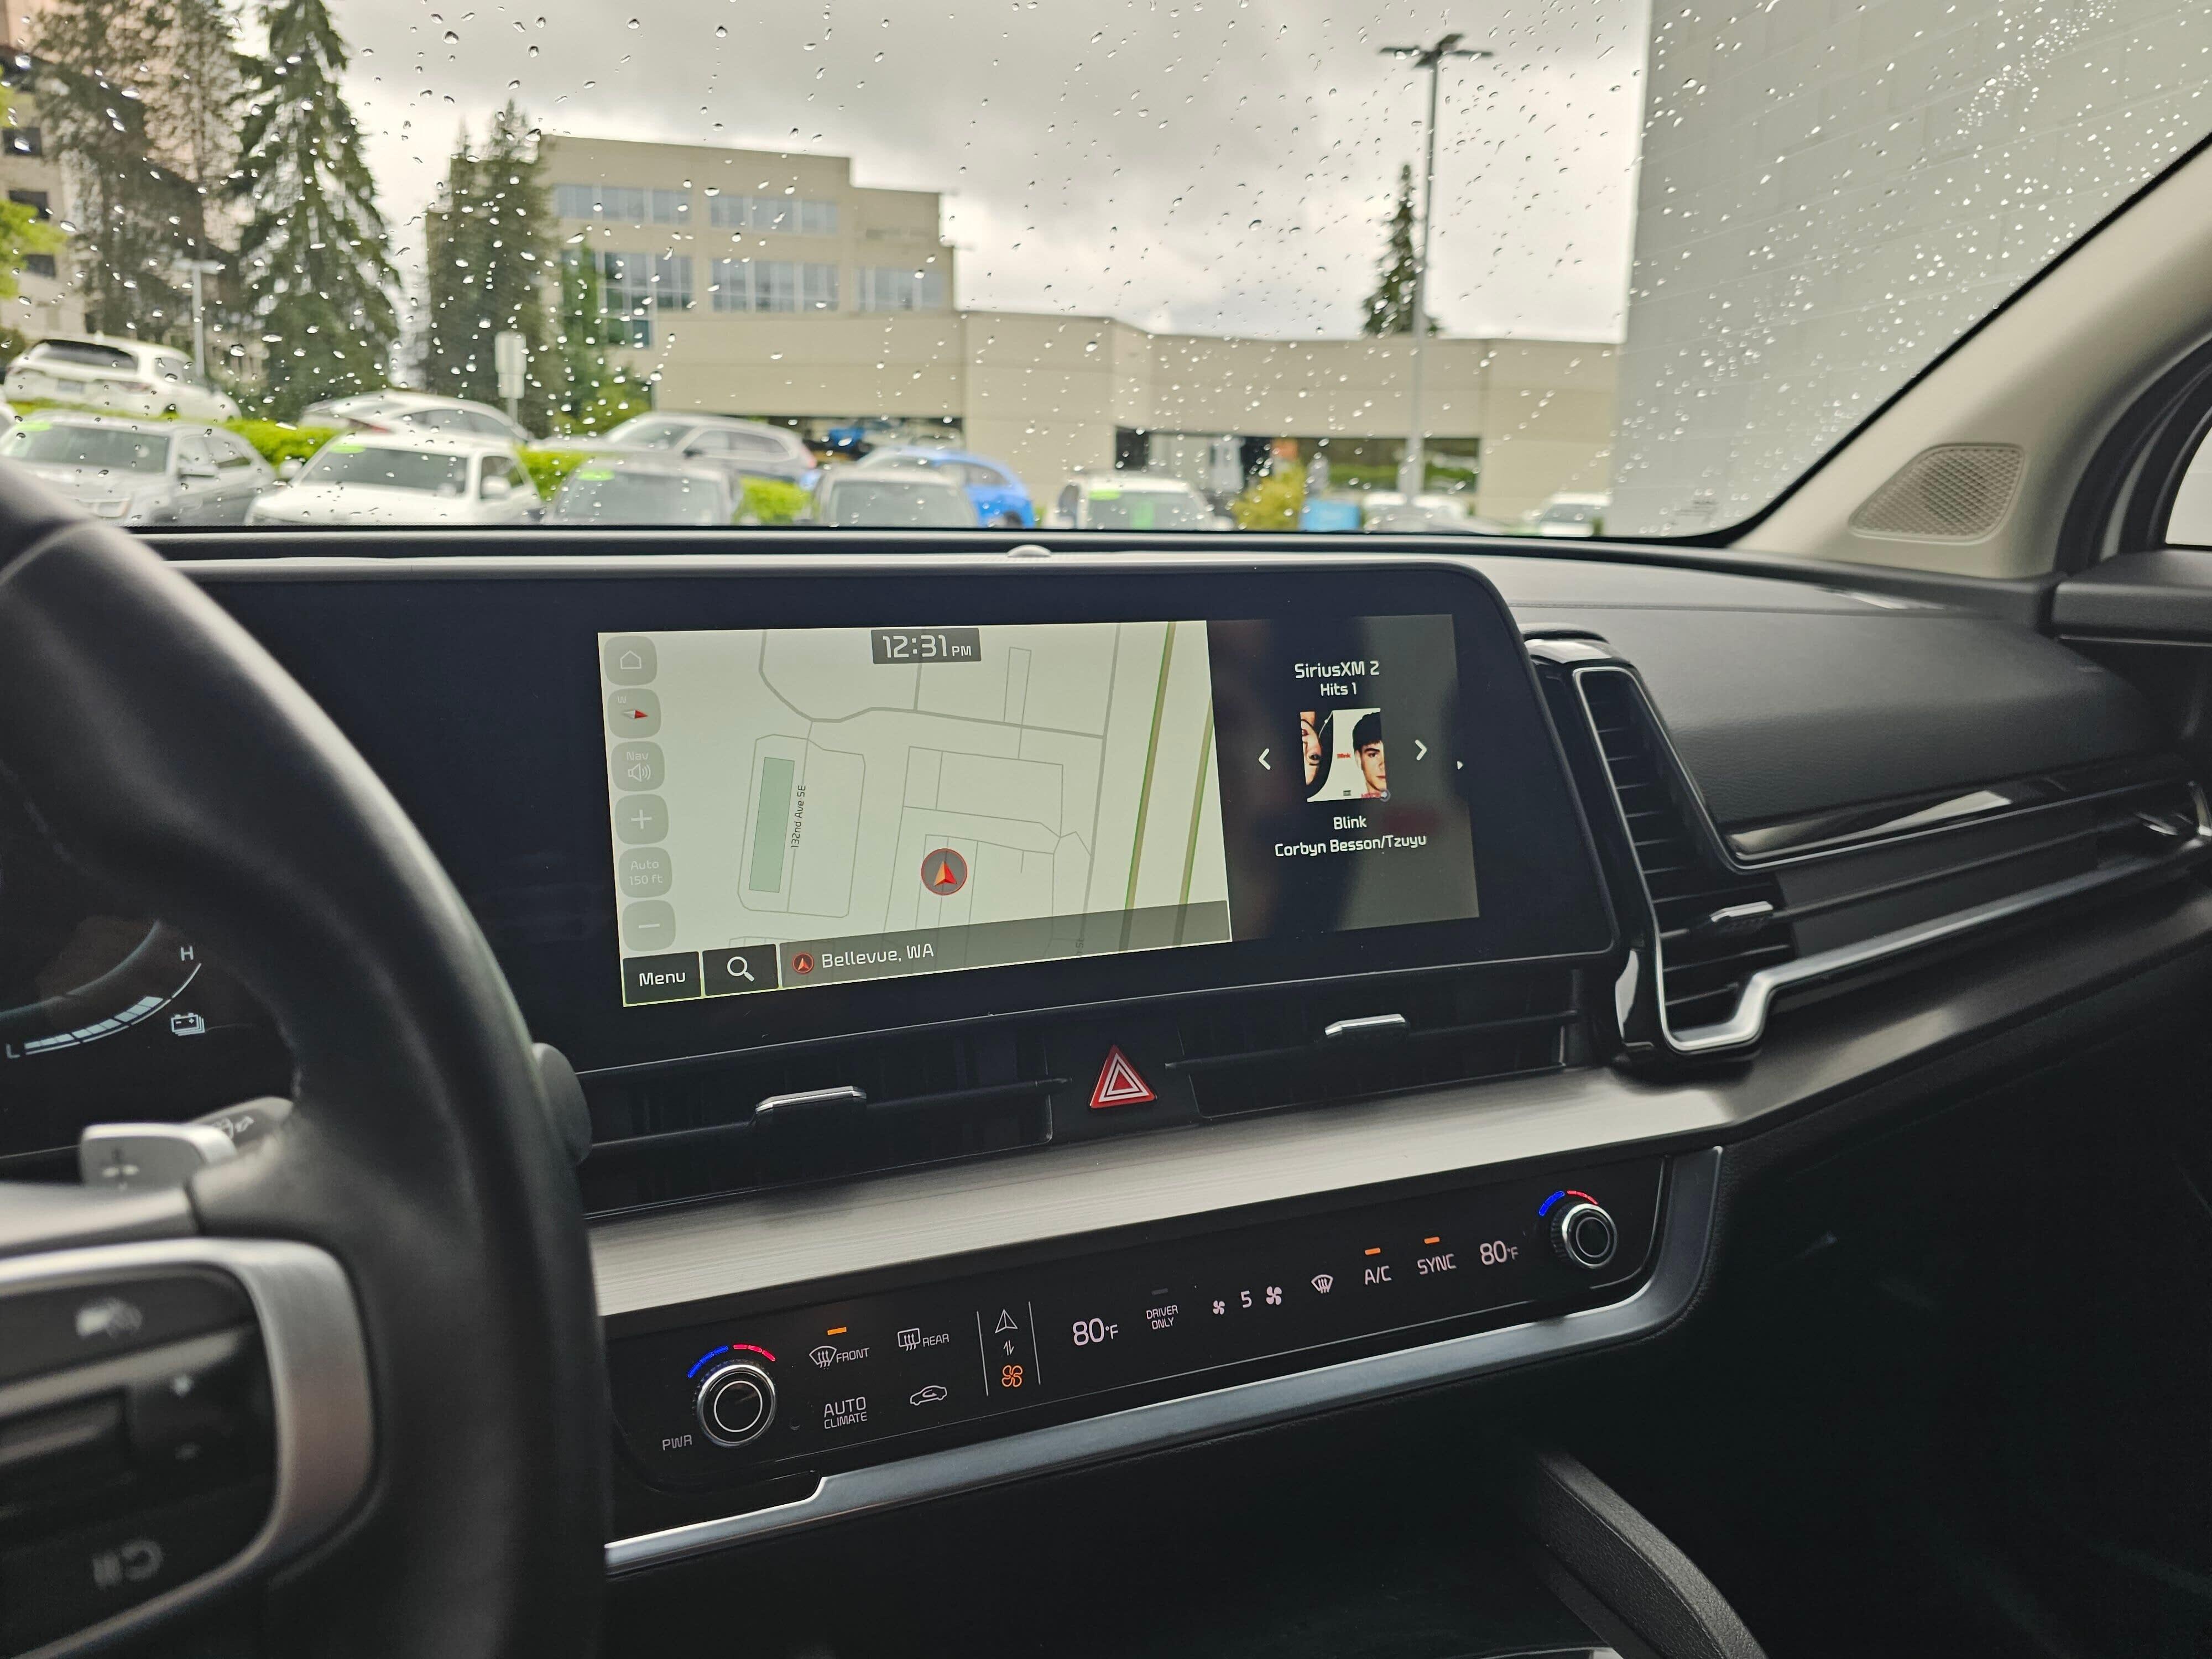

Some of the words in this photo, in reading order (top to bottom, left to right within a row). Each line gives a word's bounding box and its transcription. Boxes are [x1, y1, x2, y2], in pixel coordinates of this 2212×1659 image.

[883, 635, 948, 658] 12:31
[952, 645, 972, 656] PM
[1295, 661, 1364, 679] SiriusXM
[1369, 660, 1380, 675] 2
[1321, 682, 1348, 696] Hits
[1352, 682, 1357, 695] 1
[617, 696, 627, 704] W
[626, 752, 649, 760] Nav
[797, 785, 806, 797] SE
[795, 801, 804, 818] Ave
[1333, 816, 1367, 829] Blink
[791, 821, 801, 848] 132nd
[1275, 839, 1326, 857] Corbyn
[1330, 835, 1427, 853] Besson/Tzuyu
[630, 860, 659, 870] Auto
[629, 875, 649, 885] 150
[653, 874, 662, 883] ft
[180, 946, 194, 961] H
[822, 949, 902, 969] Bellevue,
[906, 944, 934, 958] WA
[639, 971, 686, 987] Menu
[1417, 1253, 1456, 1275] SYNC
[1364, 1266, 1391, 1286] A/C
[1241, 1290, 1253, 1308] 5
[1146, 1305, 1178, 1320] DRIVER
[1152, 1316, 1174, 1330] ONLY
[923, 1333, 950, 1347] REAR
[836, 1348, 870, 1364] FRONT
[824, 1397, 867, 1416] AUTO
[824, 1412, 868, 1430] CLIMATE
[662, 1434, 692, 1450] PWR
